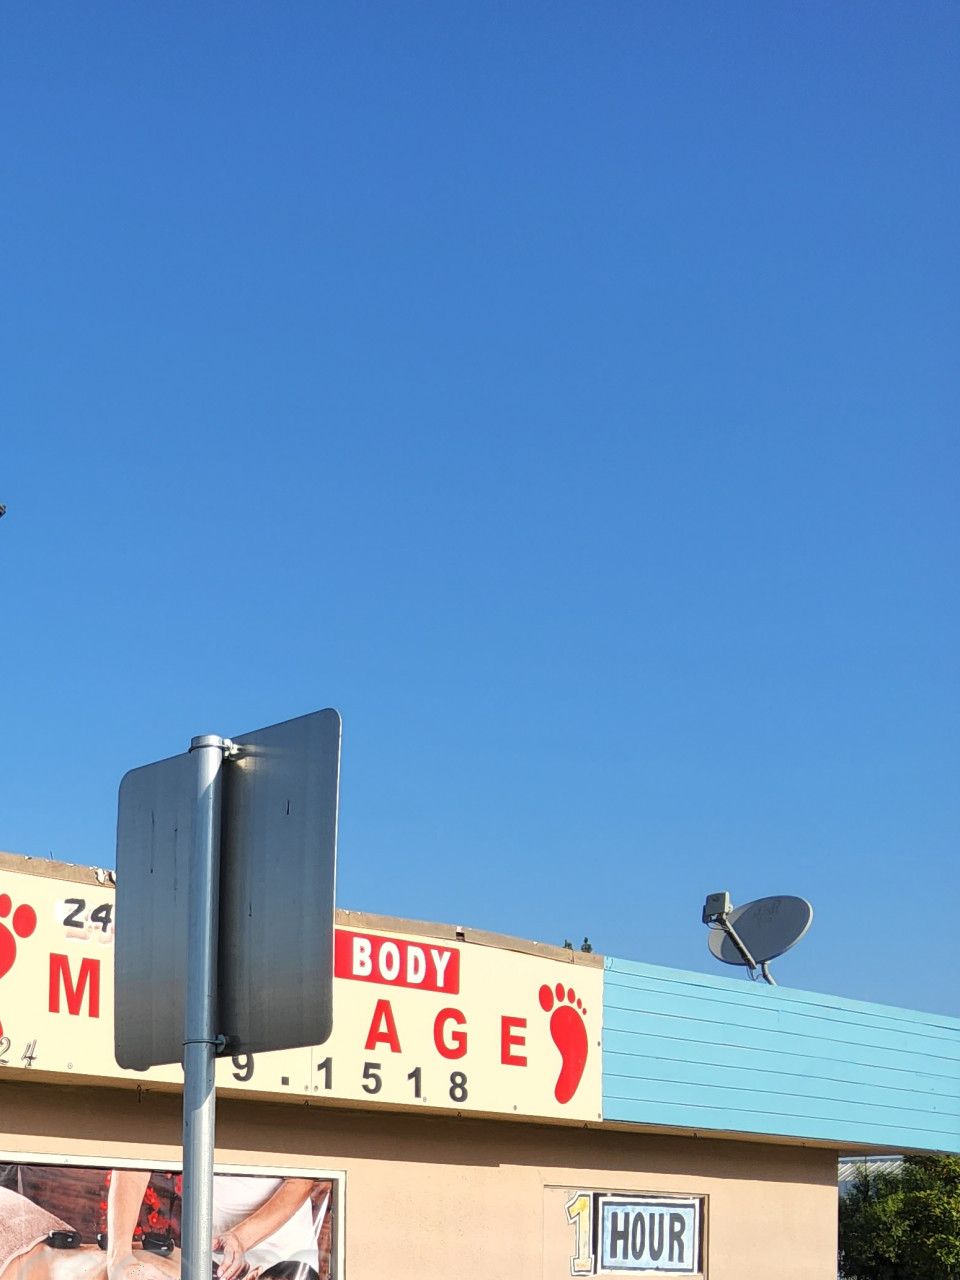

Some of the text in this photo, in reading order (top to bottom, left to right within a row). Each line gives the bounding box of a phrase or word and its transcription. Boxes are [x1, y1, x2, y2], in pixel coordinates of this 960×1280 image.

[351, 937, 451, 988] BODY
[48, 952, 528, 1067] MAGE
[565, 1191, 686, 1275] 1 HOUR
